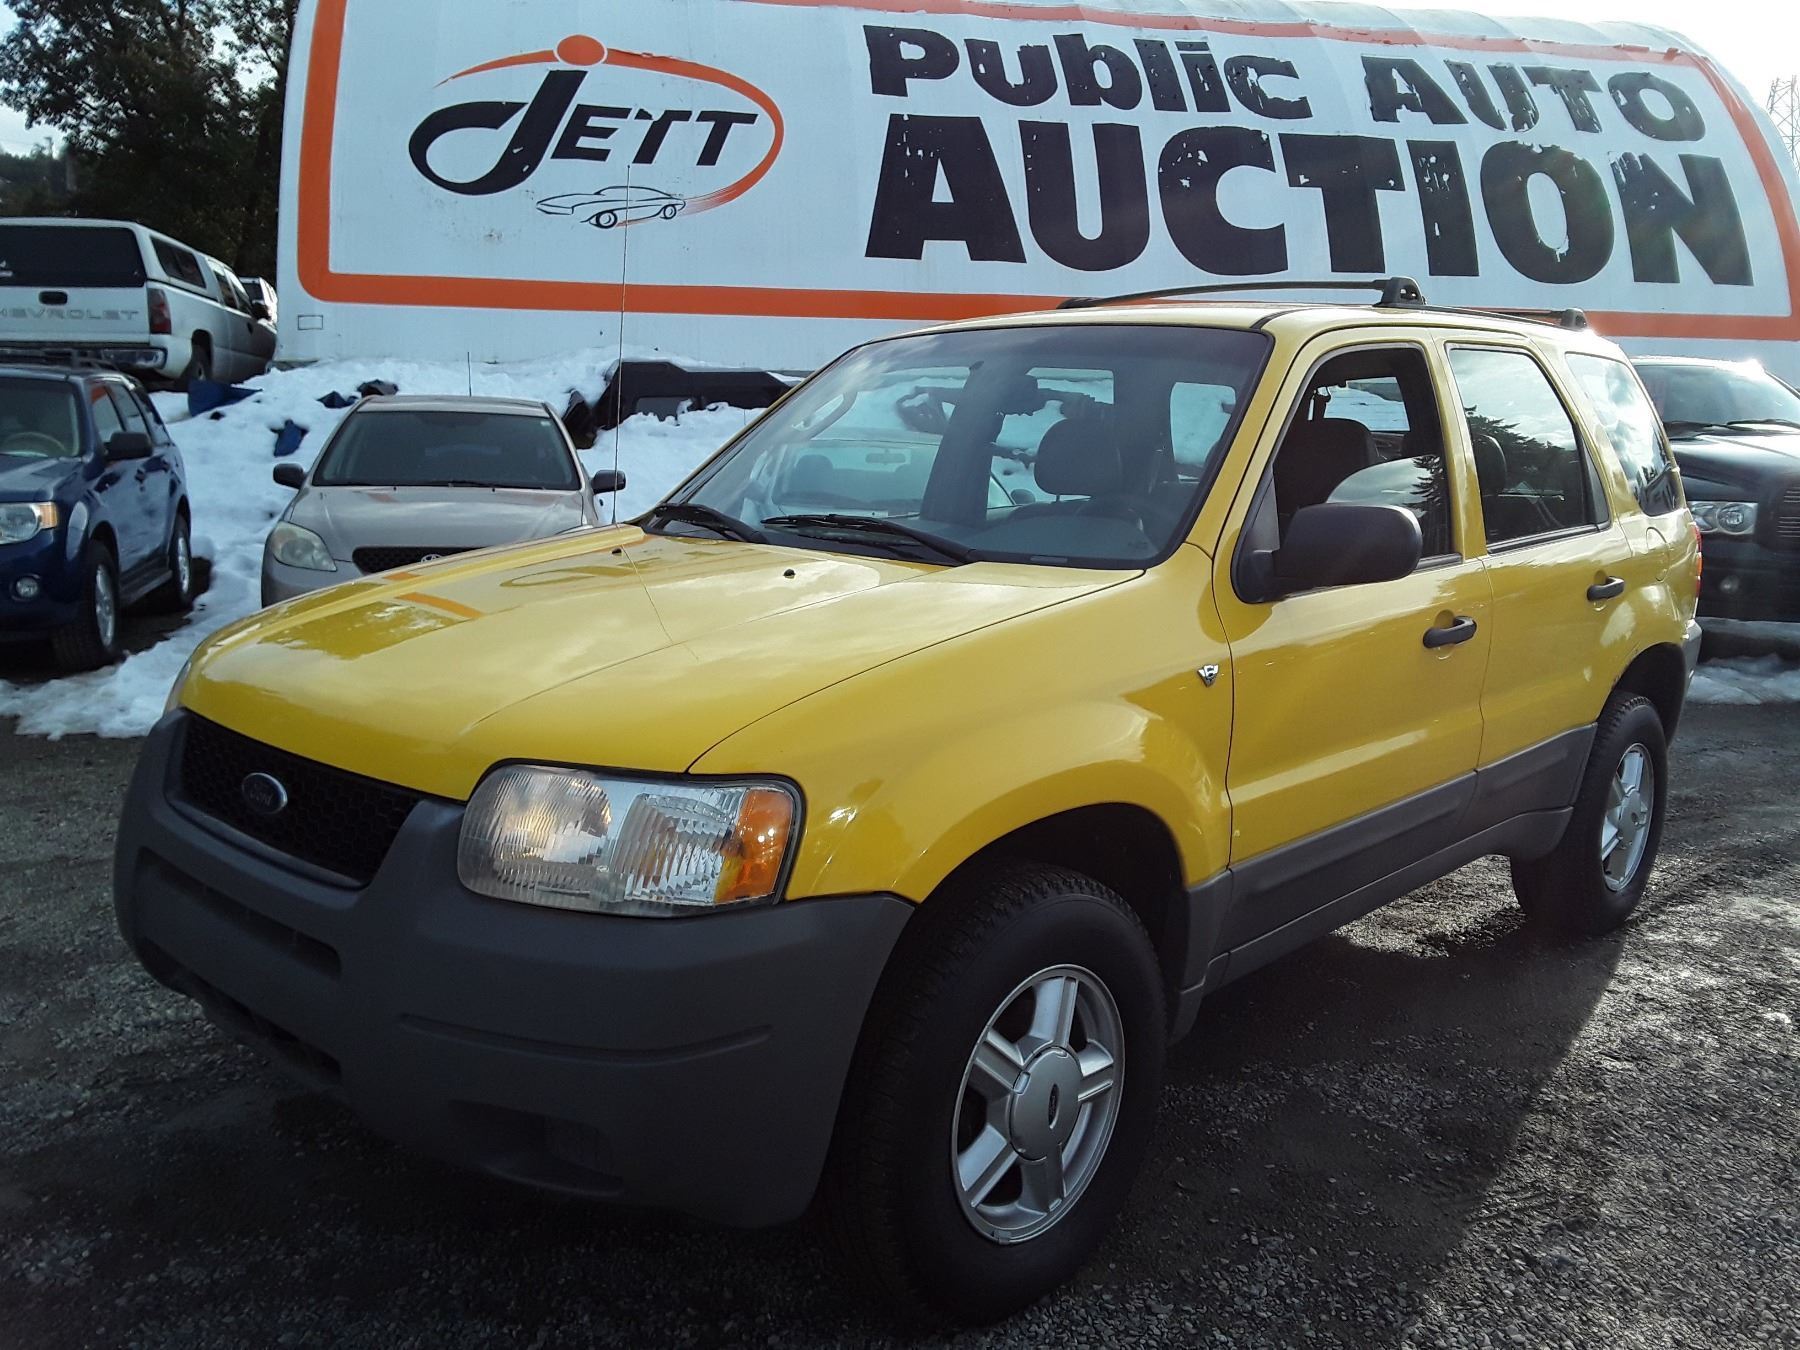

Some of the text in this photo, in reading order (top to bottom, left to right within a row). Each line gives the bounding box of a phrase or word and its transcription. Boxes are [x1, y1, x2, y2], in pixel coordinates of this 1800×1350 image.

[864, 25, 1706, 142] Public AUTO
[865, 113, 1754, 286] AUCTION
